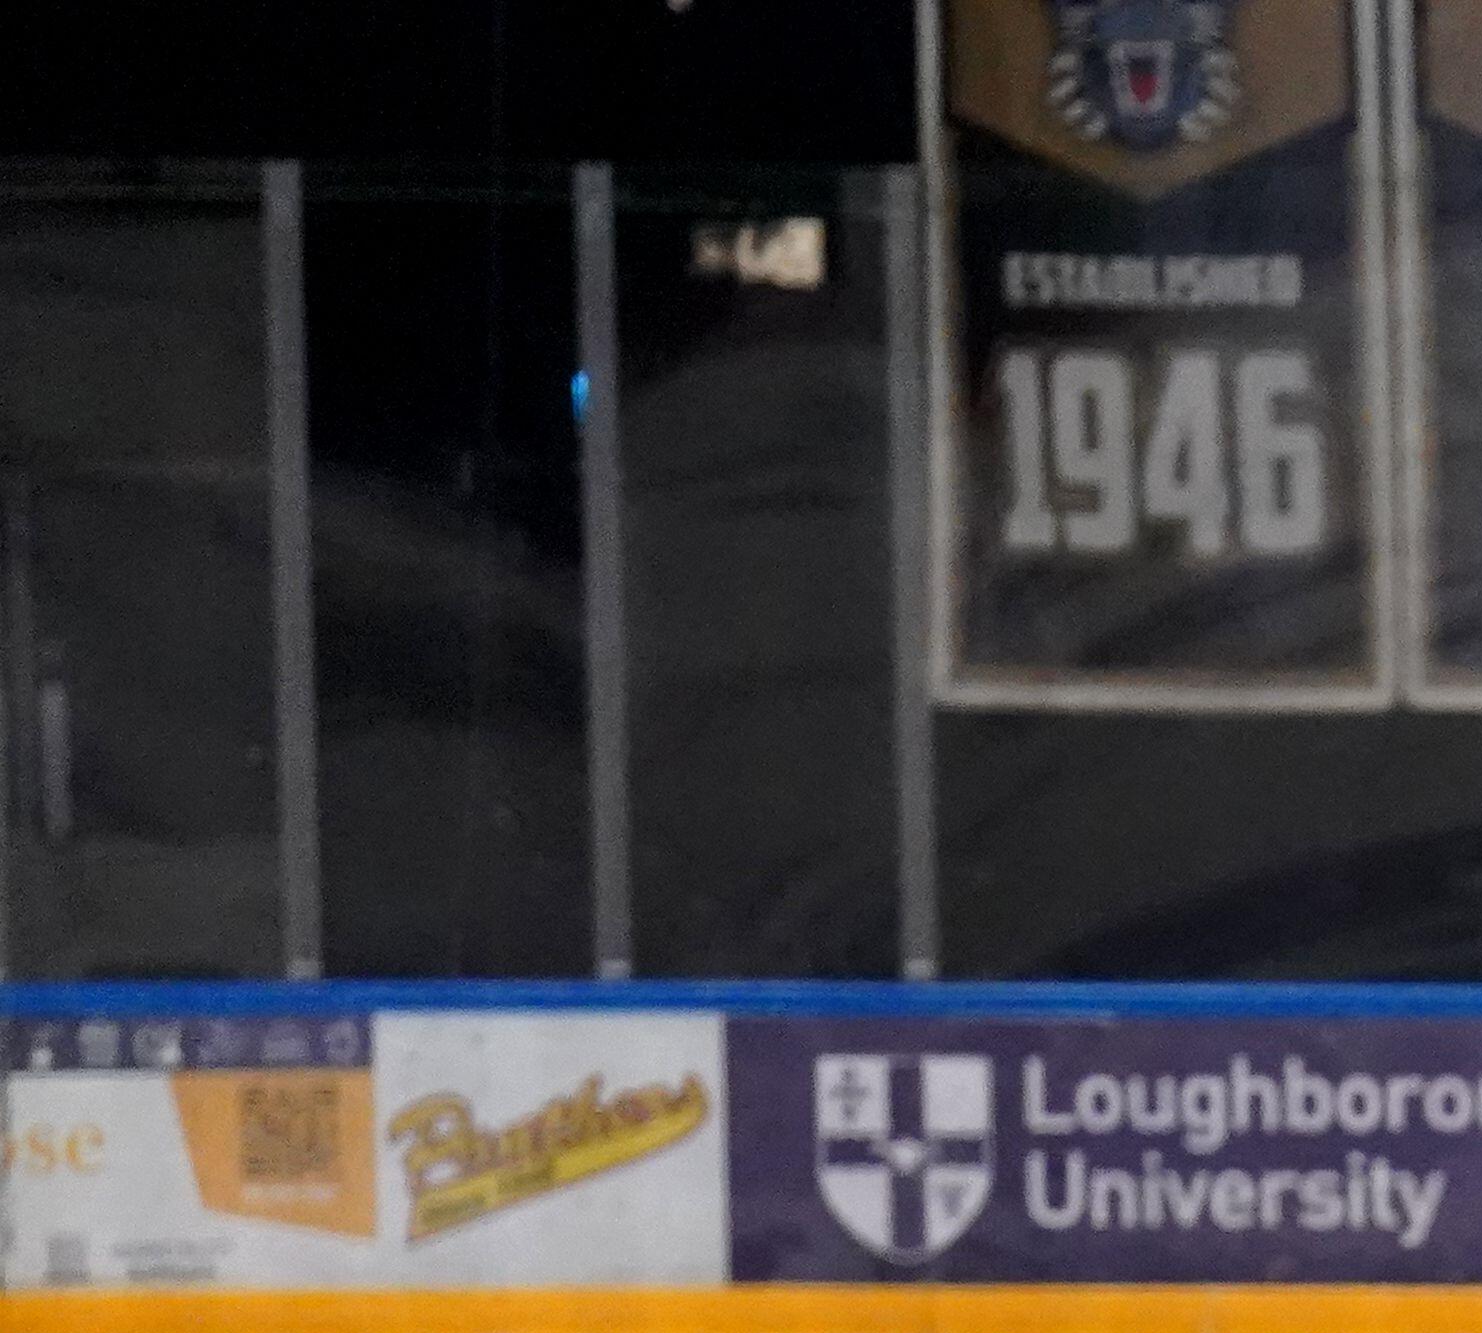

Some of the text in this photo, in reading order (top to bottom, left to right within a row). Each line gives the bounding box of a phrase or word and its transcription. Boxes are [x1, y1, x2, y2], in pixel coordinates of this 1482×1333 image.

[1005, 252, 1304, 308] ESTABLISHED
[1003, 350, 1325, 557] 1946
[1022, 1149, 1448, 1249] University
